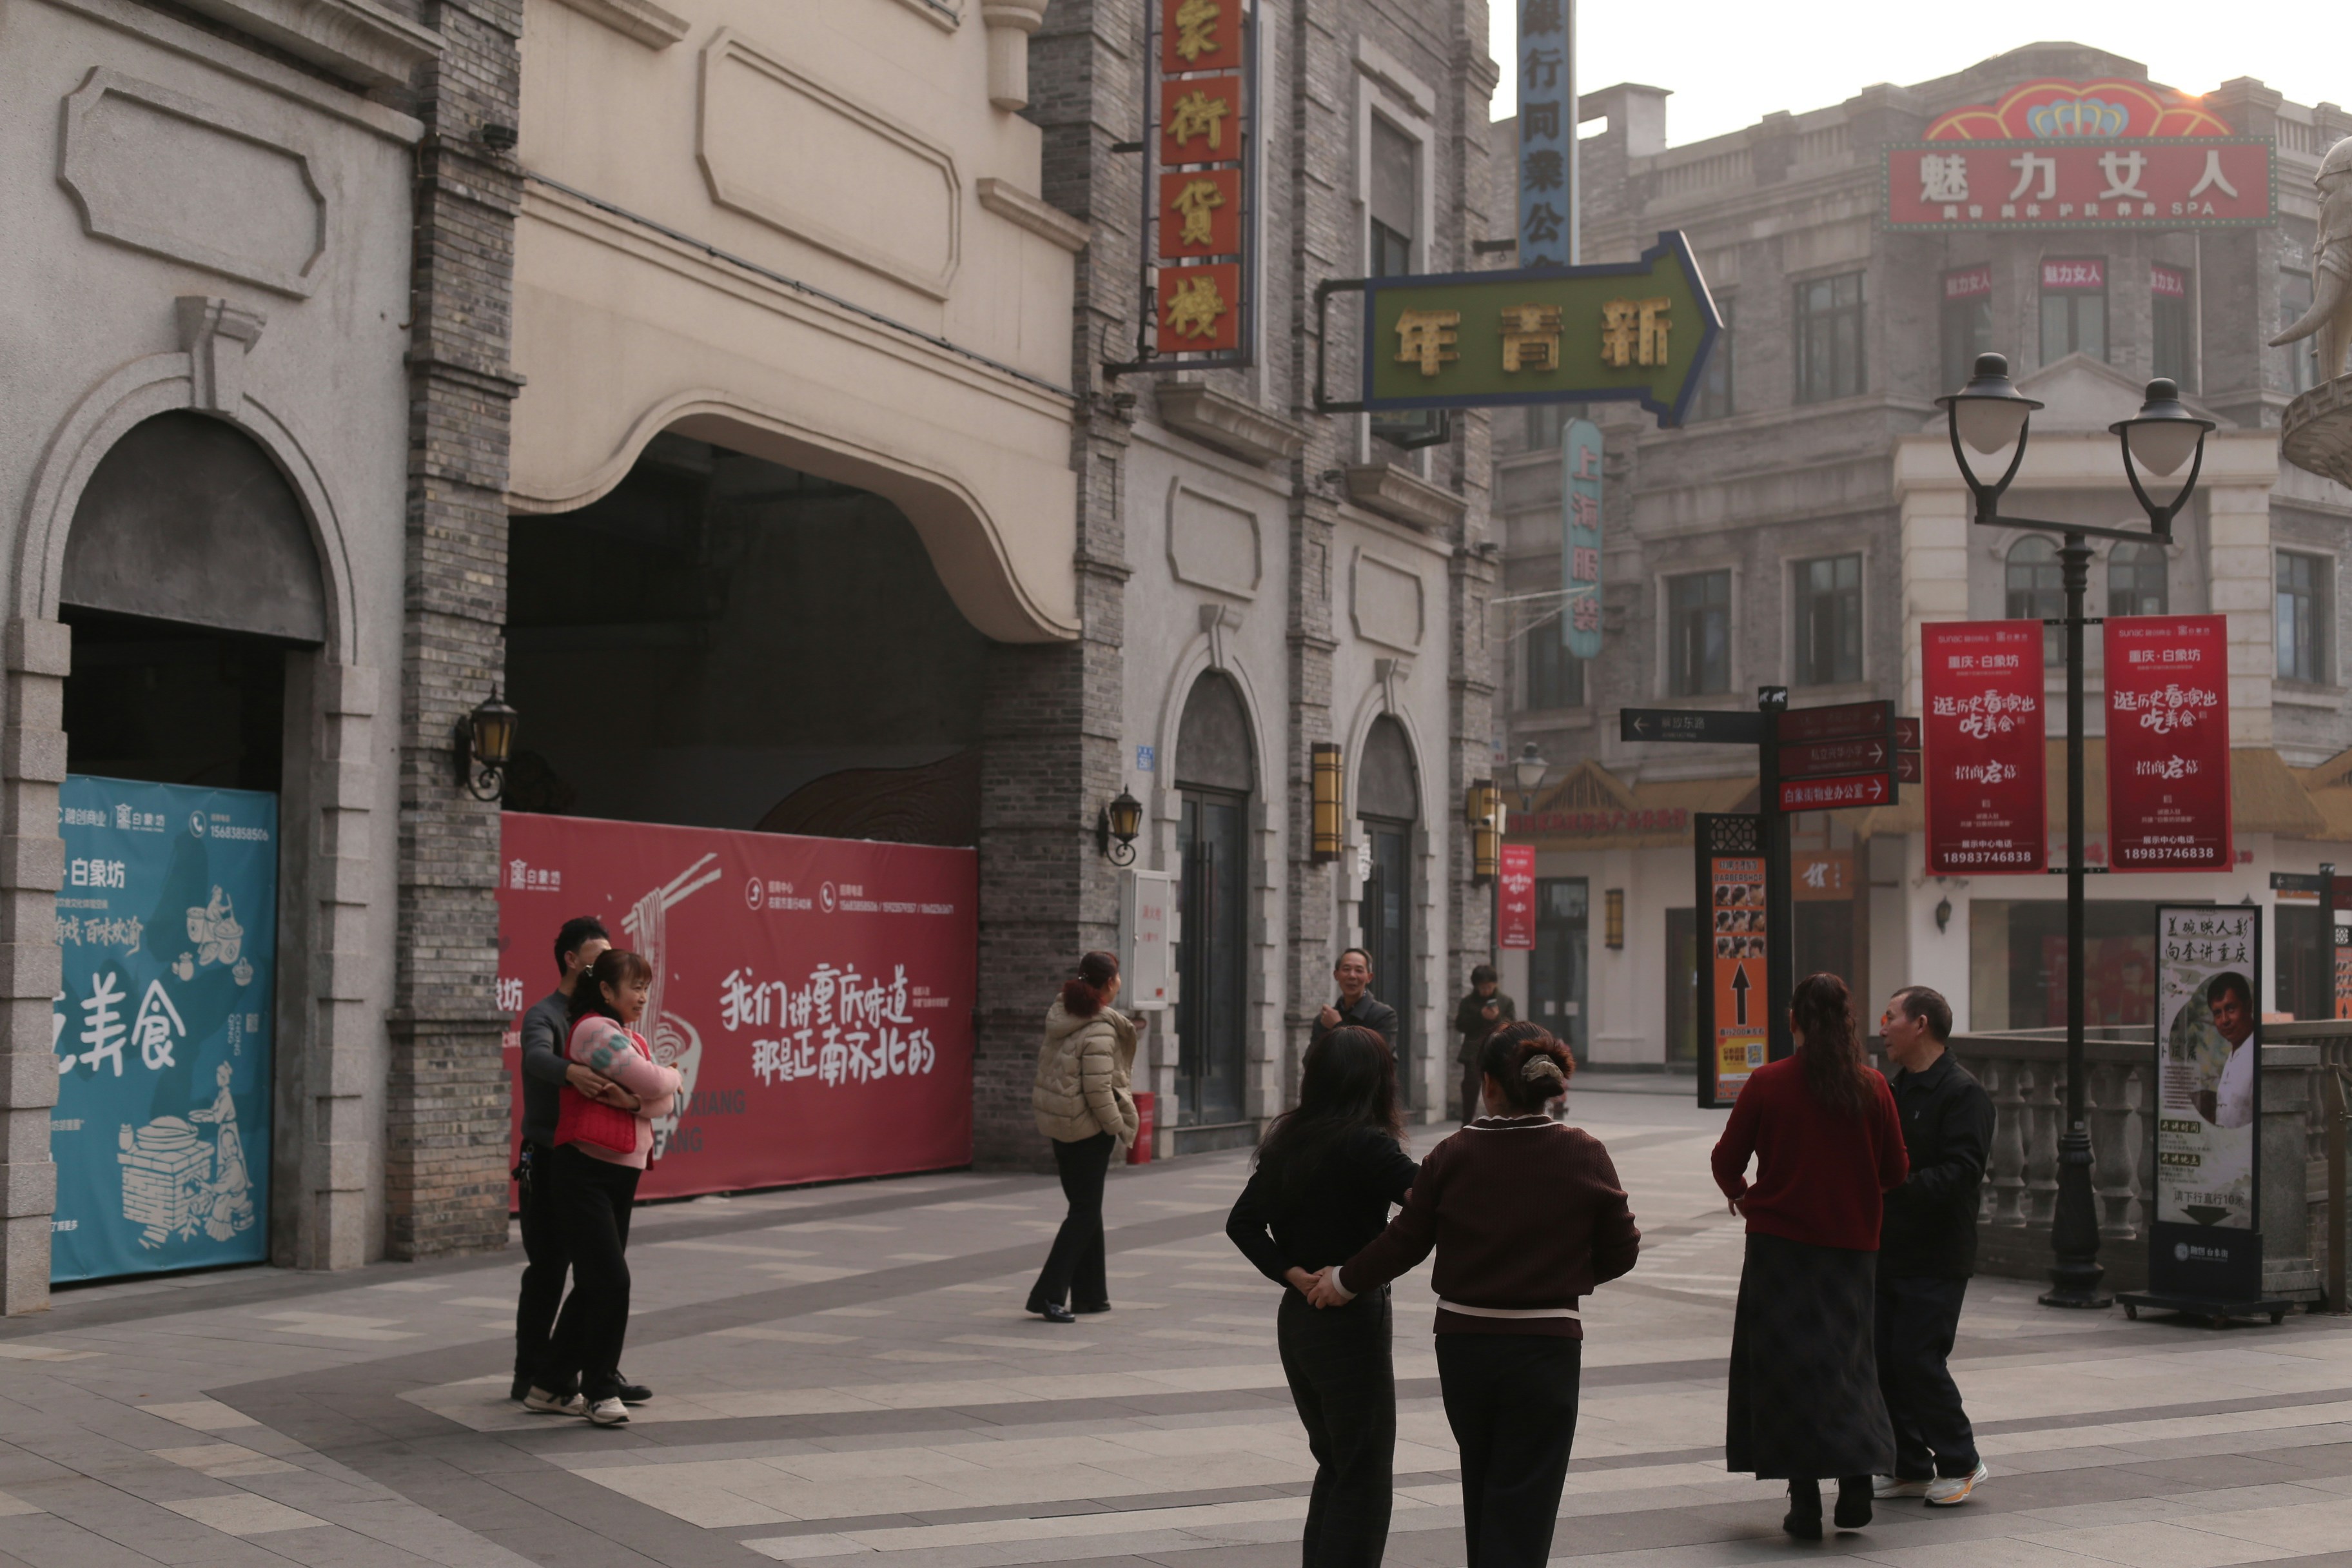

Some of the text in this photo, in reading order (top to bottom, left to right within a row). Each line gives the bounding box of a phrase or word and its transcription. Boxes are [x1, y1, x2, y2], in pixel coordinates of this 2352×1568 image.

[1920, 150, 2238, 202] 魅力女人
[1943, 204, 1983, 220] 美容
[2172, 202, 2216, 216] SPA
[2044, 263, 2102, 284] 魅力女人
[1571, 445, 1600, 633] 上海服装
[1948, 654, 2019, 669] 重庆·白象坊
[2129, 649, 2201, 663] 重庆·白象坊
[1933, 689, 2035, 716] 逛历史看演出
[2113, 683, 2218, 711] 逛历史看演出
[1661, 716, 1705, 730] 解放东路
[1959, 712, 2015, 740] 吃美食
[2140, 707, 2197, 734] 吃美食
[1810, 745, 1863, 761] 私立兴华小学
[1785, 783, 1865, 804] 白象街物业办公室
[1961, 839, 2013, 849] 展示中心电话
[2142, 835, 2195, 845] 展示中心电话
[1943, 851, 2032, 863] 18983746838
[2124, 847, 2215, 860] 18983746838
[1714, 873, 1763, 882] BARBERSHOP
[2167, 916, 2248, 939] 盖碗映人影
[2165, 941, 2249, 963] 向奎讲重庆
[720, 963, 915, 1032] 我们讲重庆味道
[751, 1026, 935, 1088] 那是正南齐北的
[690, 1089, 746, 1117] XIANG
[654, 1126, 702, 1155] FANG
